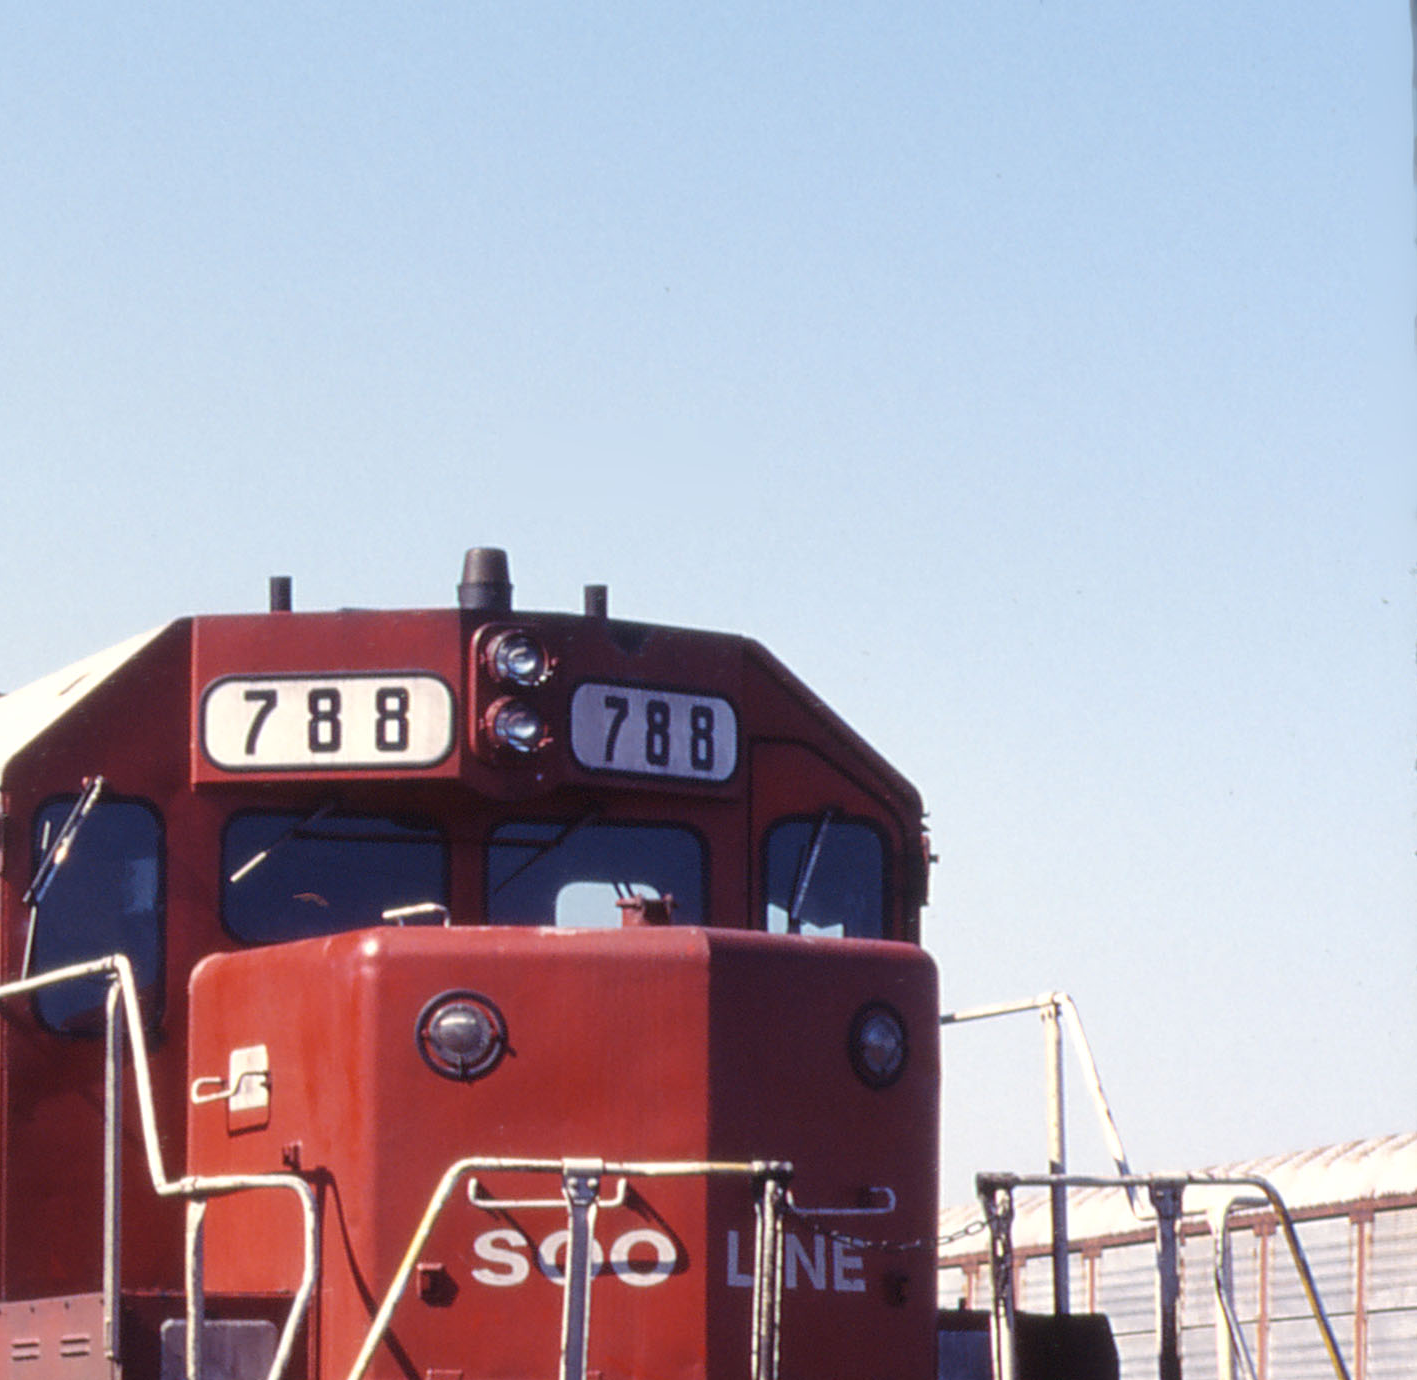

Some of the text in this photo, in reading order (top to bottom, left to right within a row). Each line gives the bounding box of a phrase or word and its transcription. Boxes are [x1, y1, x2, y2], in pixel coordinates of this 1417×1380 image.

[243, 687, 410, 755] 788
[603, 697, 715, 772] 788
[471, 1229, 866, 1292] SOO LNE
